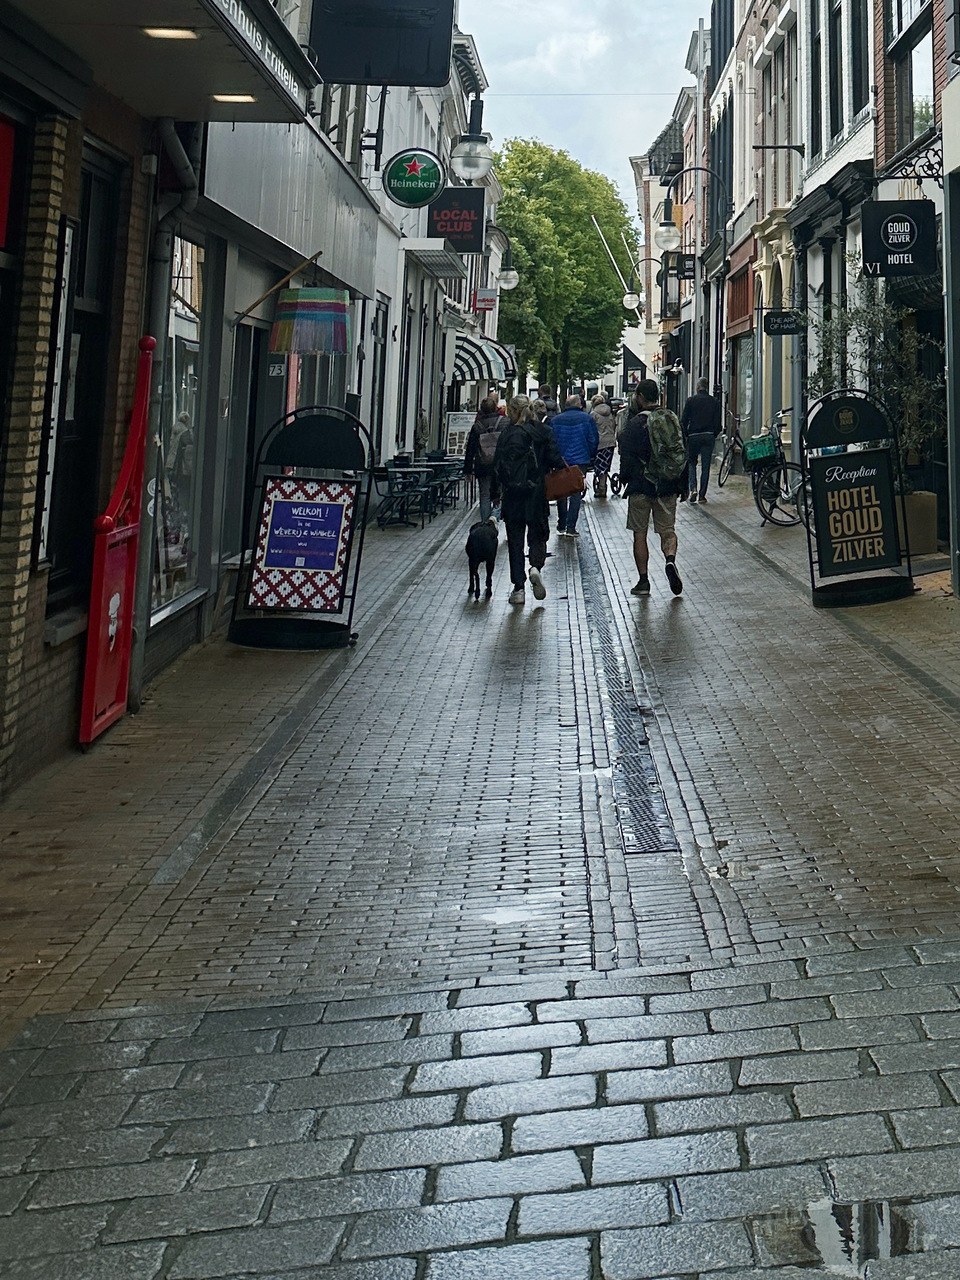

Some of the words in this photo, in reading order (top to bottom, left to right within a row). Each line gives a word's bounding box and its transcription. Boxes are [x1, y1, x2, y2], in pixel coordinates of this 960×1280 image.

[264, 37, 300, 99] Frittella
[390, 179, 436, 189] Heineken
[433, 209, 478, 221] LOCAL
[436, 221, 473, 232] CLUB
[887, 222, 910, 233] GOUD
[888, 234, 911, 243] ZILVER
[887, 254, 914, 265] HOTEL
[865, 262, 881, 274] VI
[270, 365, 283, 375] 73
[825, 466, 877, 483] Reception
[827, 485, 880, 511] HOTEL
[291, 506, 322, 517] WELKOM
[828, 507, 883, 539] GOUD
[832, 537, 886, 564] ZILVER
